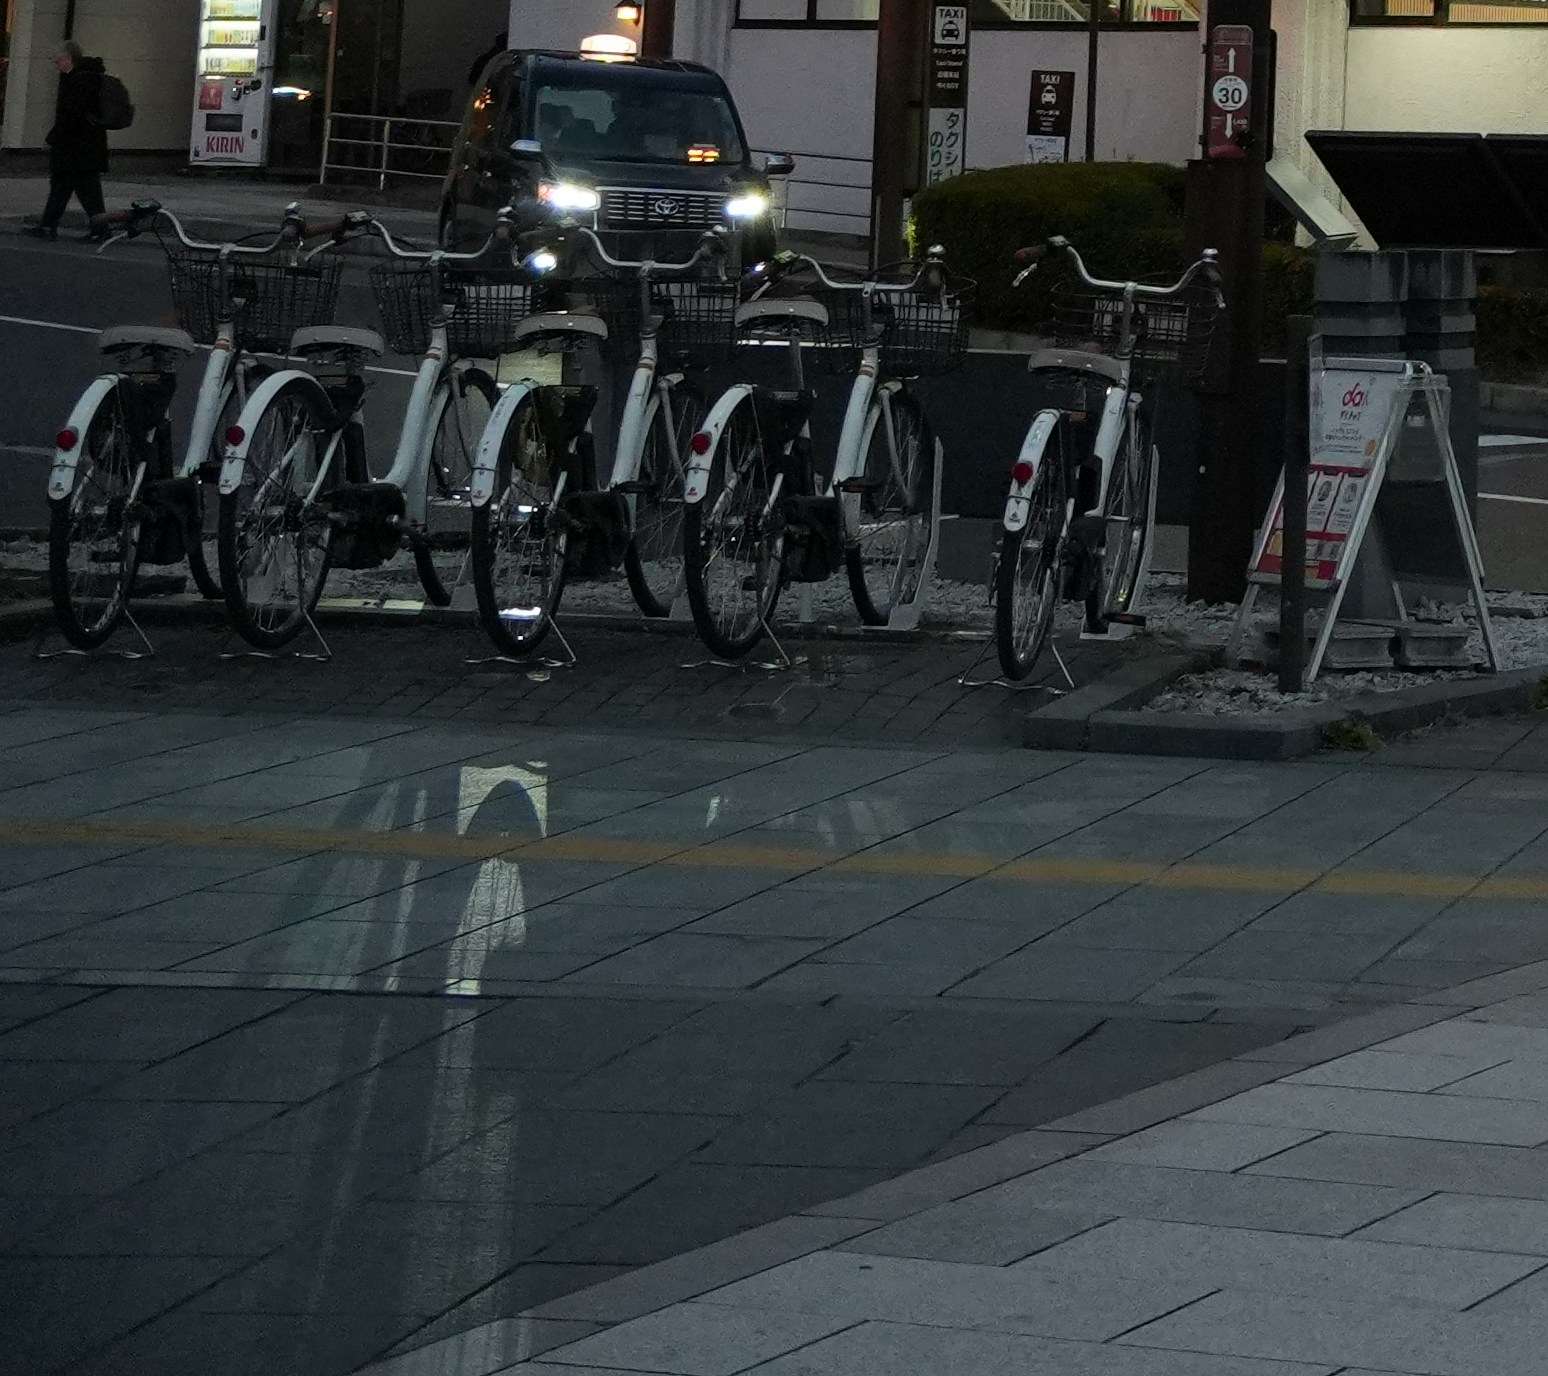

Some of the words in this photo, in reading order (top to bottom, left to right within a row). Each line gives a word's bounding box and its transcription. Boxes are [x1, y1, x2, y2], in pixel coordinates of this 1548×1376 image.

[939, 9, 964, 19] TAXI
[1040, 74, 1060, 85] TAXI
[1218, 87, 1242, 104] 30
[206, 136, 244, 154] KIRIN
